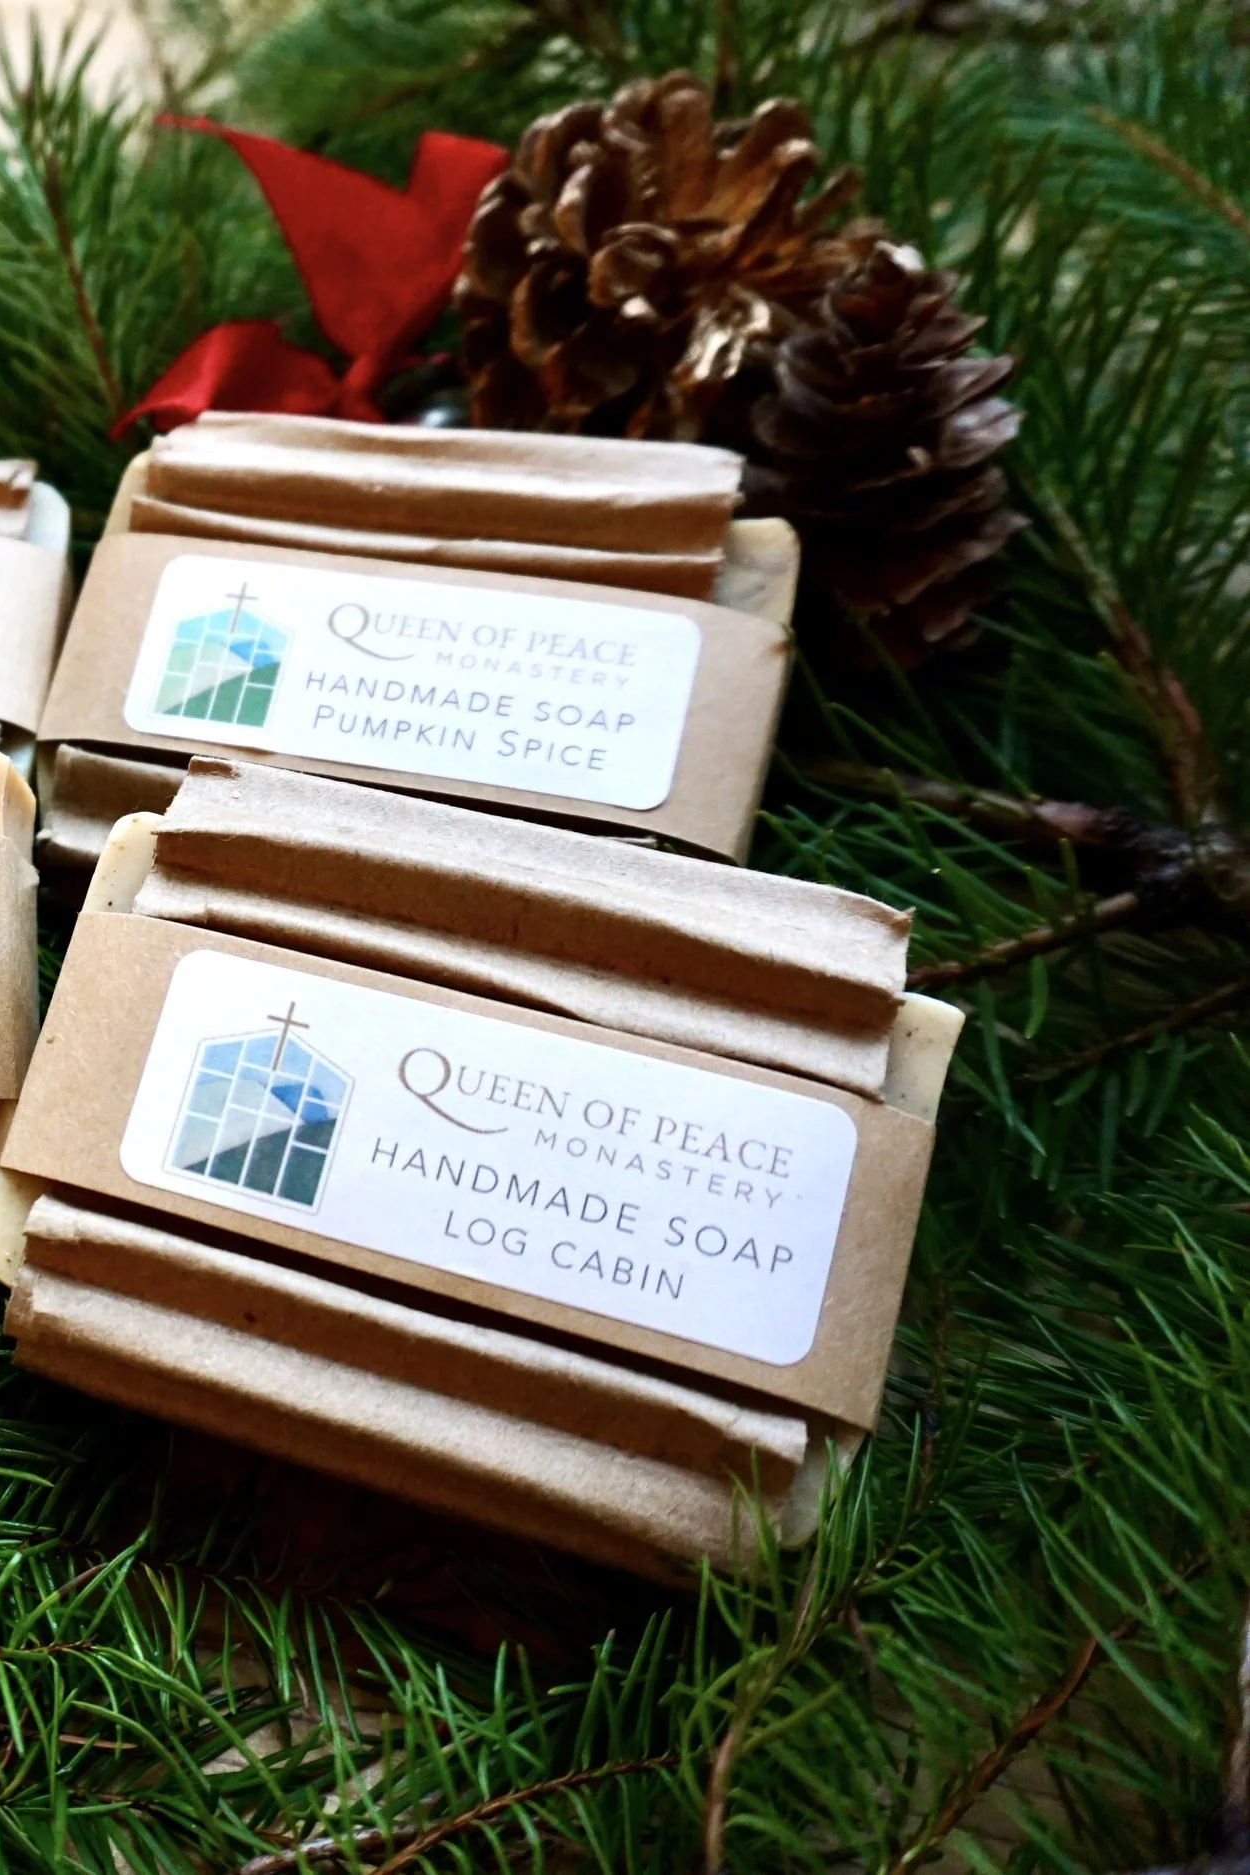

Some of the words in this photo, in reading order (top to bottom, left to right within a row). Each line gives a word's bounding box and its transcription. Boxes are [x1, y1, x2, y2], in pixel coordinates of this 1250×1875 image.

[327, 603, 461, 661] QUEEN
[472, 623, 518, 651] OF
[526, 632, 637, 667] PEACE
[435, 650, 630, 689] MONASTERY
[305, 669, 515, 717] HANDMADE
[533, 699, 637, 734] SOAP
[312, 704, 476, 751] PUMPKIN
[497, 730, 608, 771] SPICE
[398, 1047, 572, 1134] QUEEN
[582, 1099, 641, 1135] OF
[650, 1115, 794, 1178] PEACE
[370, 1136, 640, 1235] HANDMADE
[664, 1215, 795, 1274] SOAP
[534, 1128, 784, 1210] MONASTERY
[444, 1209, 528, 1256] LOG
[551, 1240, 684, 1300] CABIN
